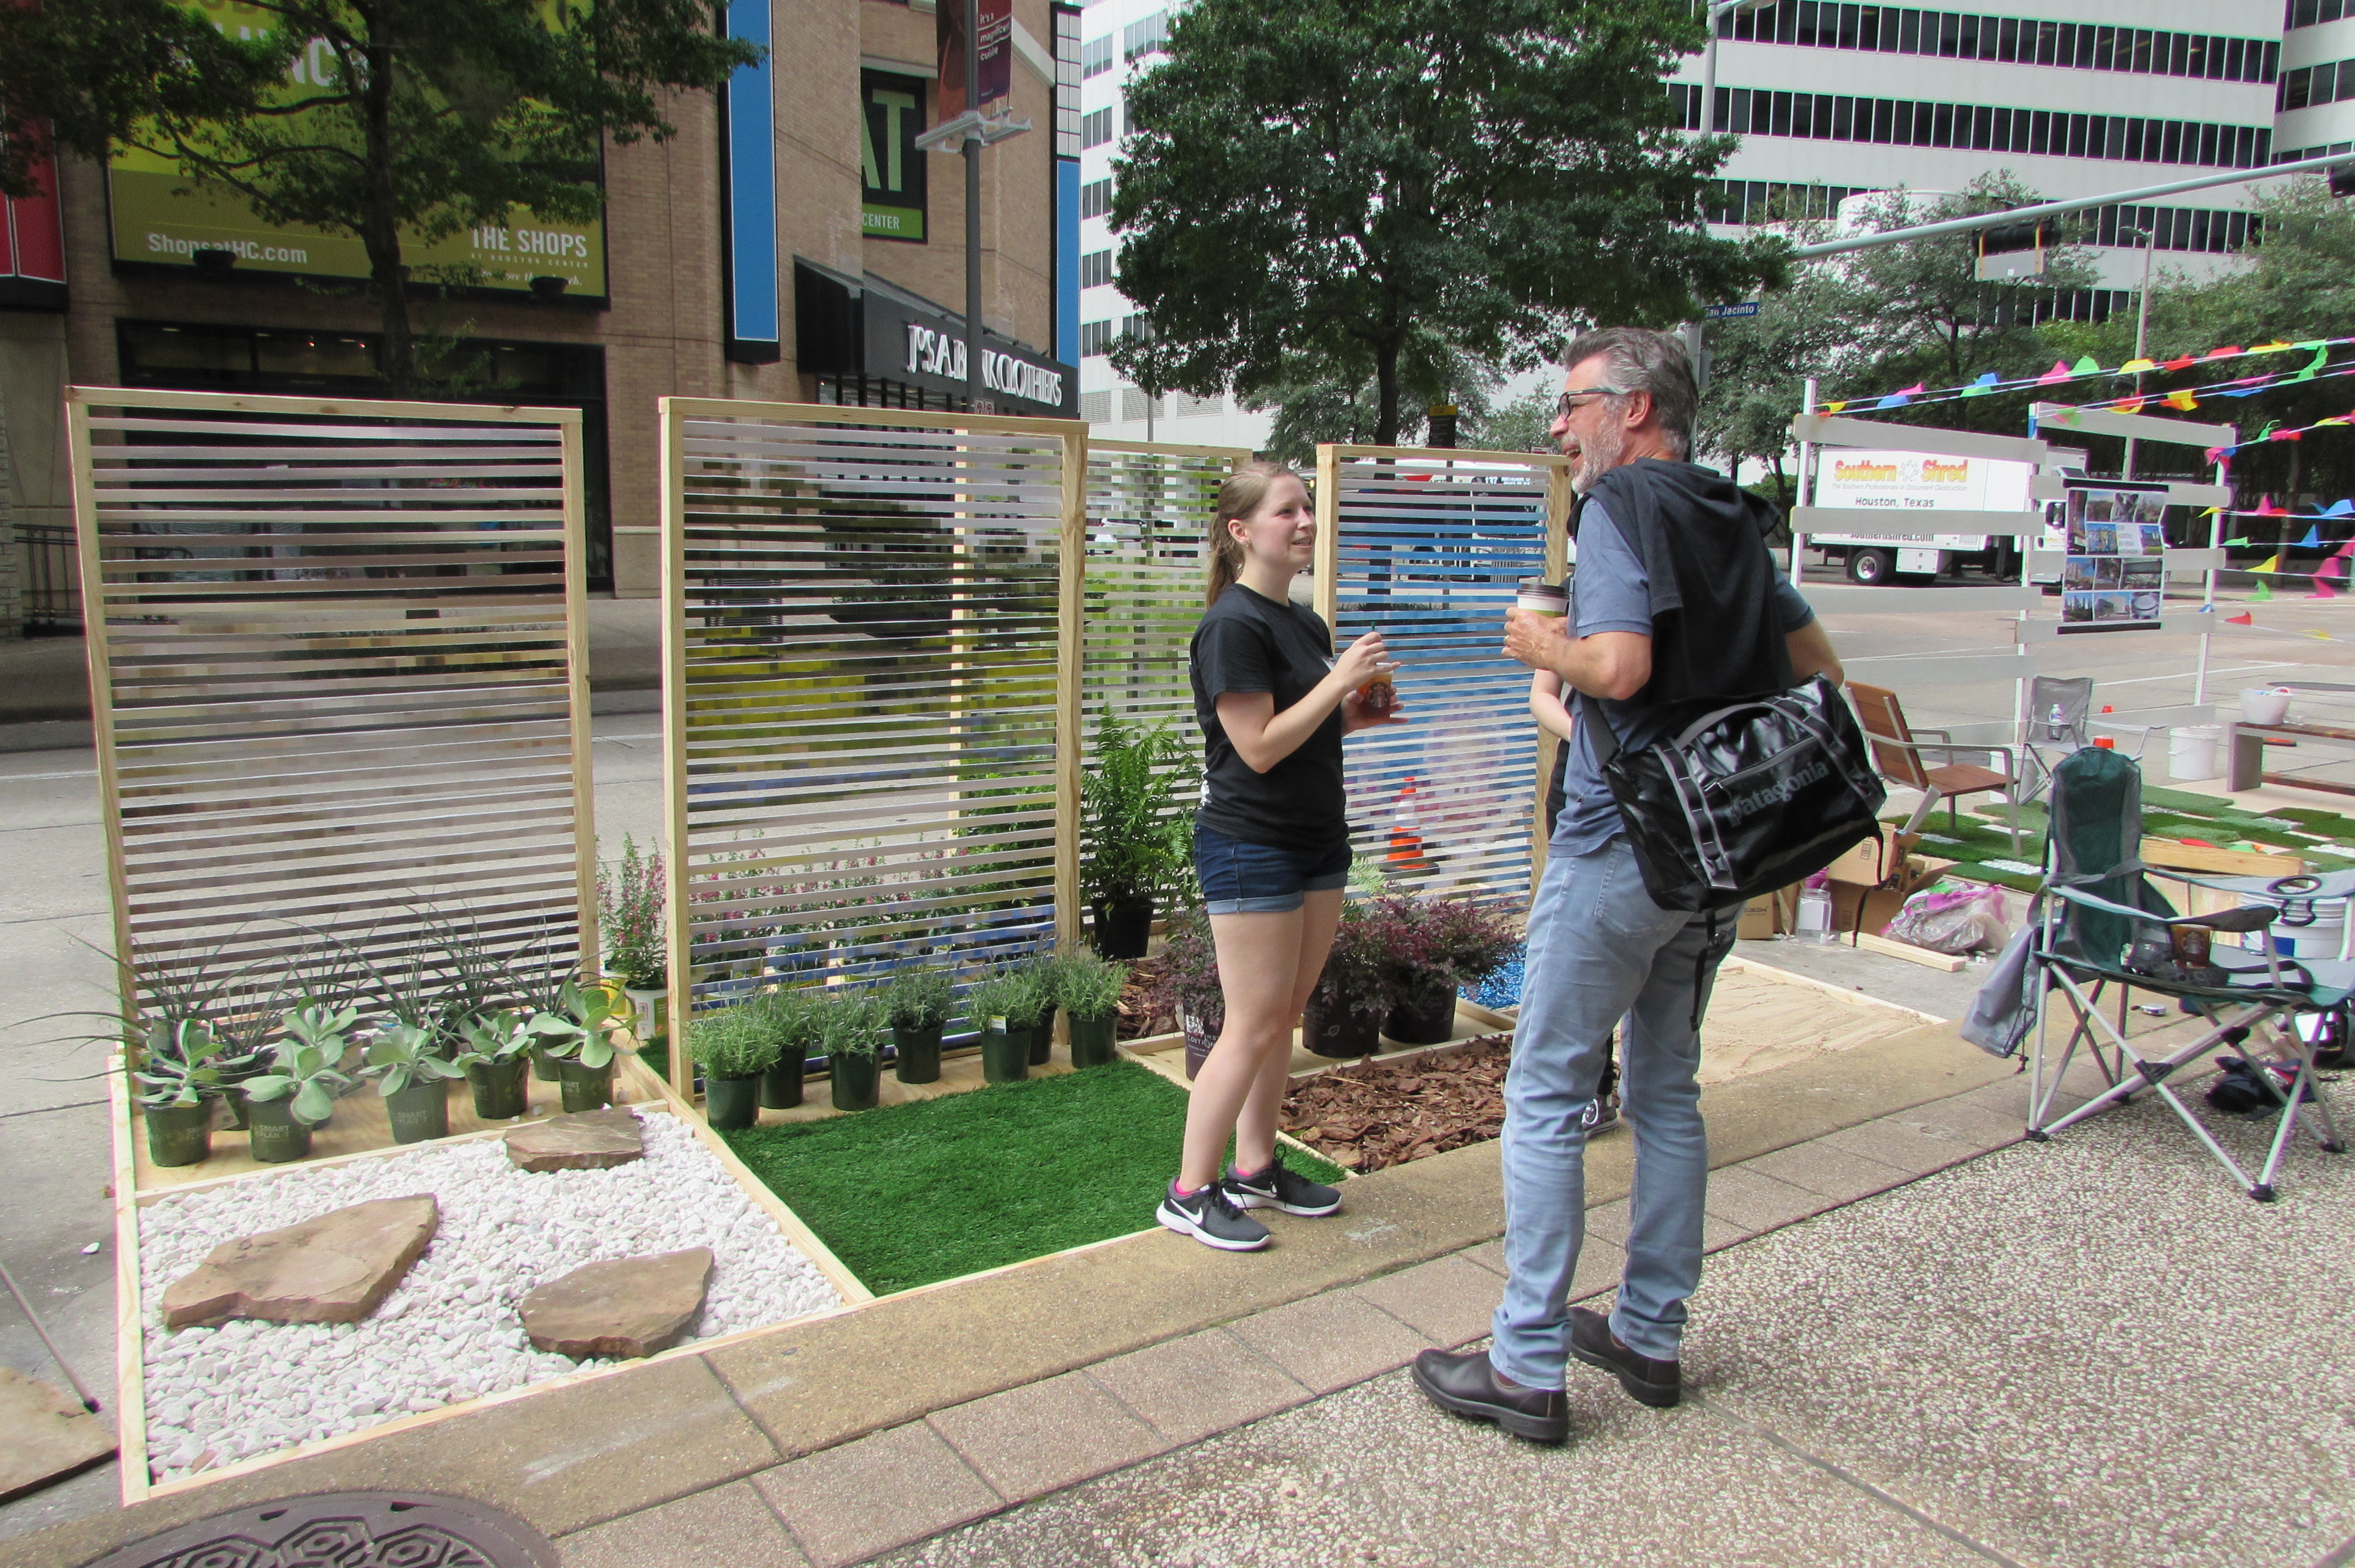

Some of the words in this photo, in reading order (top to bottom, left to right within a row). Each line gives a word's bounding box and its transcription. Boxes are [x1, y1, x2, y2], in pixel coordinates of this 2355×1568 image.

[980, 14, 990, 25] it's
[863, 213, 900, 230] CENTER
[472, 225, 511, 251] THE
[518, 230, 588, 258] SHOPS
[490, 255, 540, 264] HOUSTON
[549, 259, 588, 269] CENTER
[1722, 305, 1754, 316] Jacinto
[996, 354, 1062, 407] CLOTHIERS
[1834, 460, 1898, 482] Southern
[1921, 459, 1968, 483] Shred
[1855, 497, 1899, 508] Houston,
[1904, 498, 1934, 507] Texas
[1724, 761, 1829, 828] patagonia
